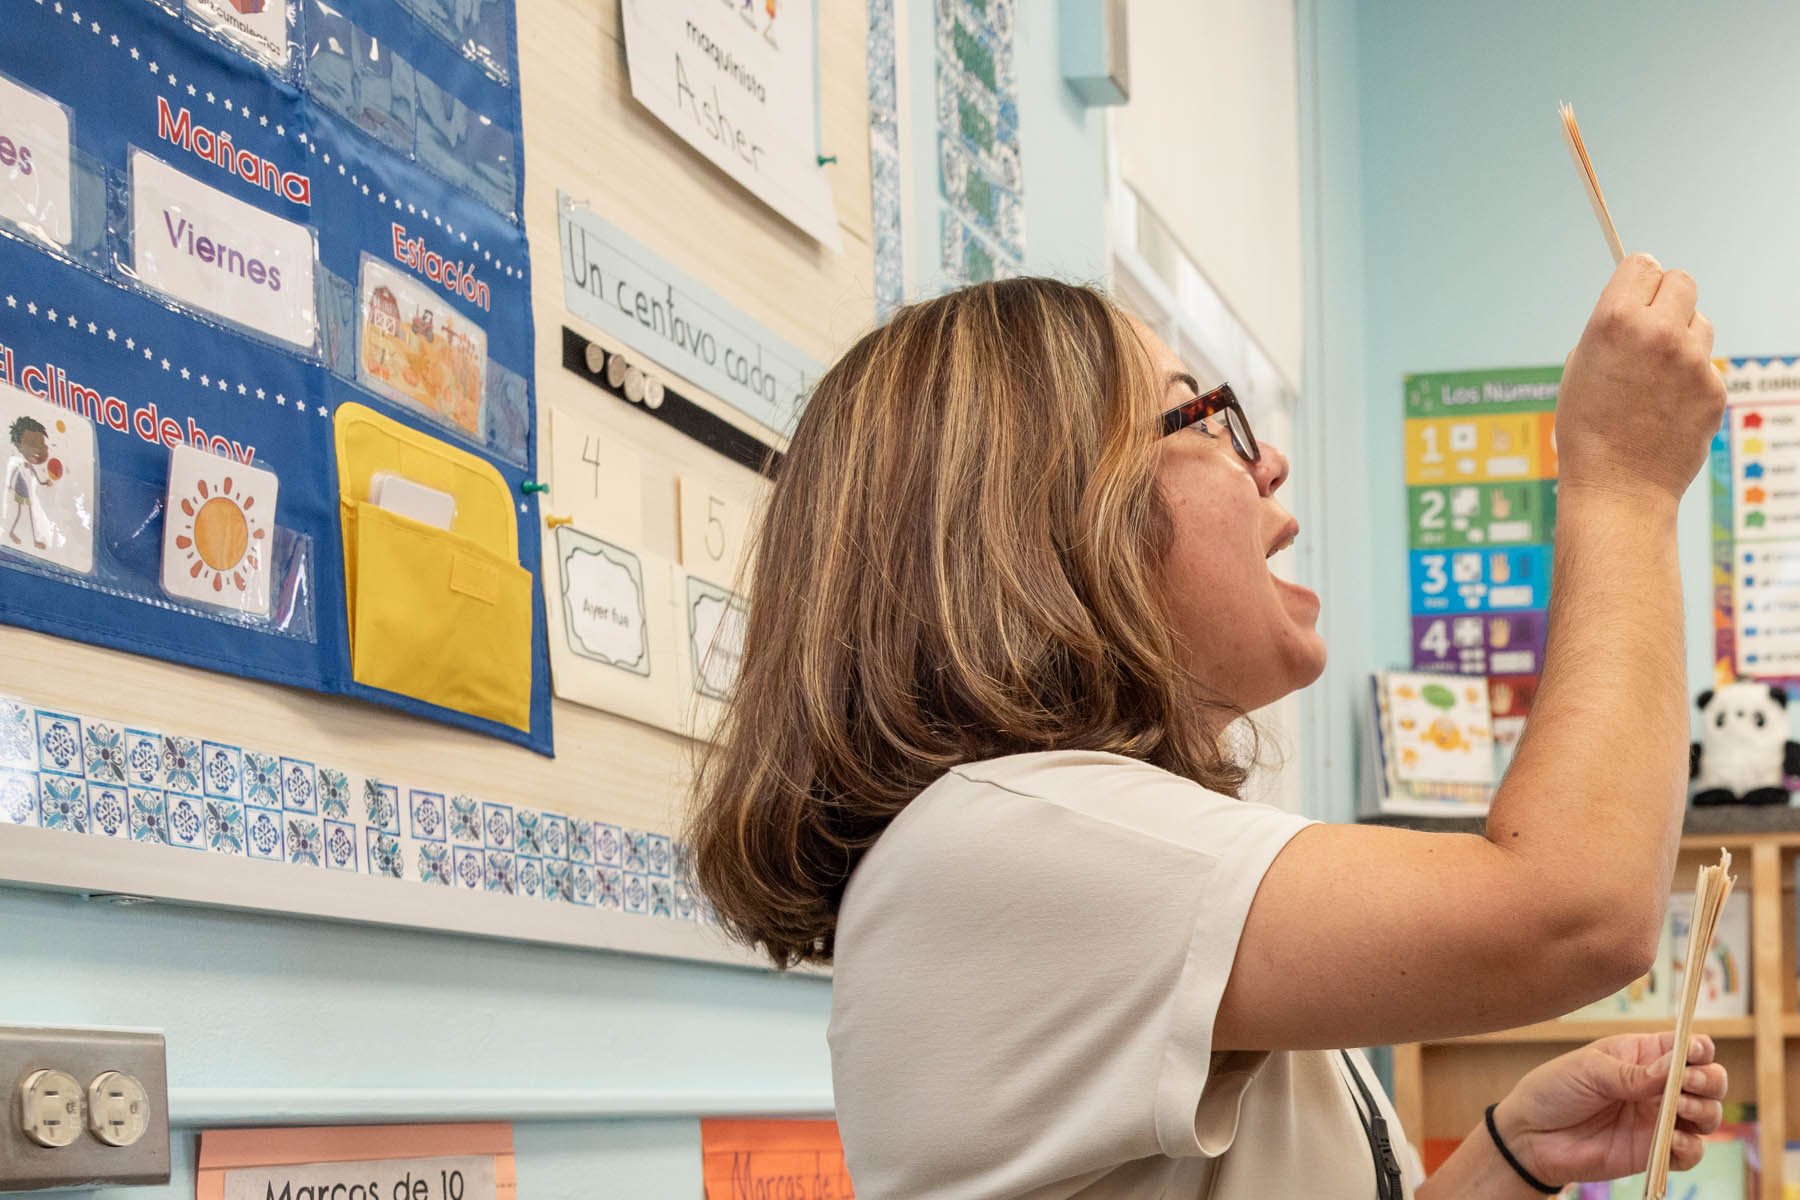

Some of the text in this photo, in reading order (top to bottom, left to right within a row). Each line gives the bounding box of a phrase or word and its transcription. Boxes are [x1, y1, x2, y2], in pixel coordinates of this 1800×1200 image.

[675, 51, 766, 170] Asher
[157, 95, 311, 206] Mañana
[163, 209, 281, 293] Viernes
[391, 222, 491, 312] Estación
[568, 221, 603, 300] Un
[617, 285, 717, 366] centavo
[725, 343, 777, 403] cada
[21, 363, 129, 434] clima
[133, 402, 184, 449] de
[582, 435, 601, 499] 4
[1420, 425, 1444, 464] 1
[705, 495, 726, 562] 5
[1418, 490, 1447, 529] 2
[1420, 554, 1448, 594] 3
[1420, 620, 1451, 658] 4
